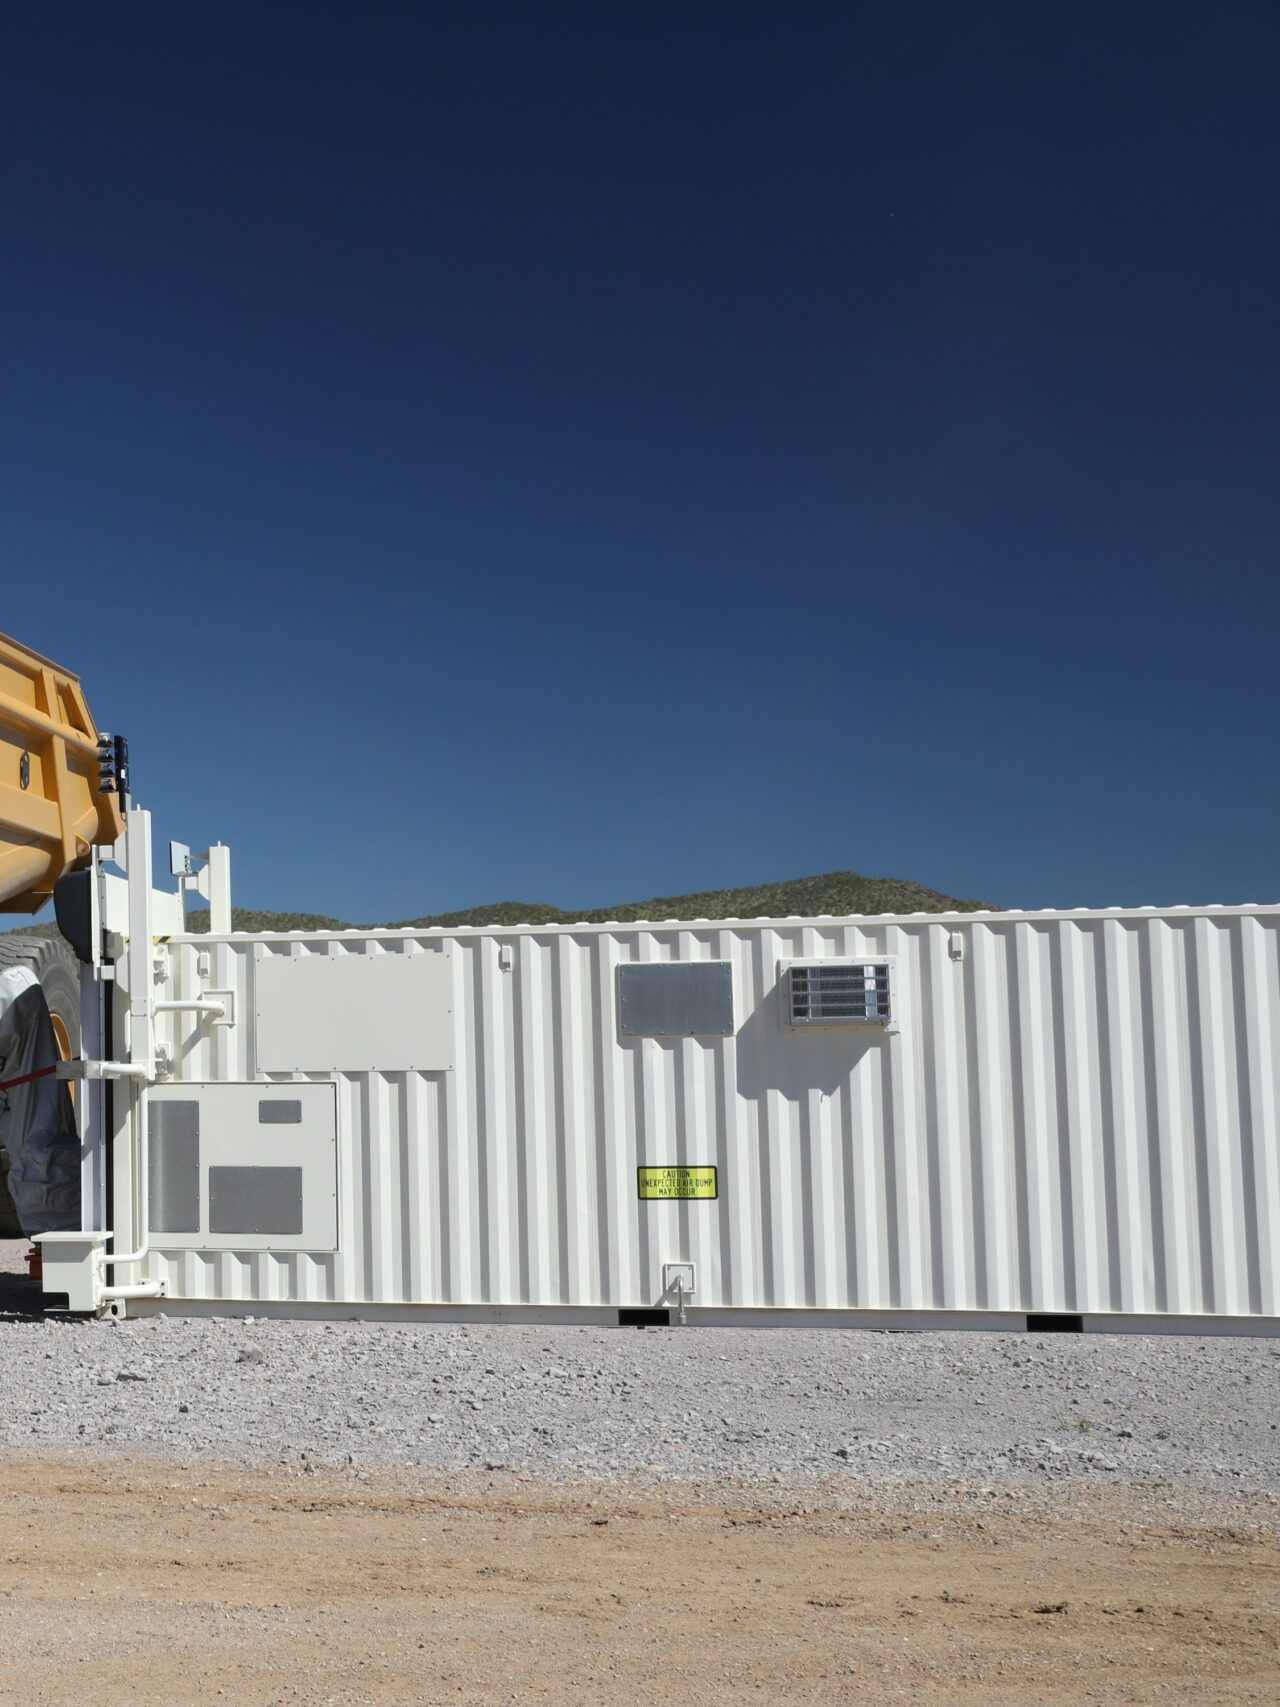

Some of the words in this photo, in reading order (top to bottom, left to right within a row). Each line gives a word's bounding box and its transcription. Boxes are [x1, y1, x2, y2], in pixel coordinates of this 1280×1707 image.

[662, 1170, 690, 1179] CAUTION
[640, 1179, 680, 1188] UNEXPECTED
[682, 1179, 694, 1188] AIR
[695, 1179, 713, 1188] DUMP
[659, 1188, 672, 1196] MAY
[674, 1188, 696, 1196] OCCUR
